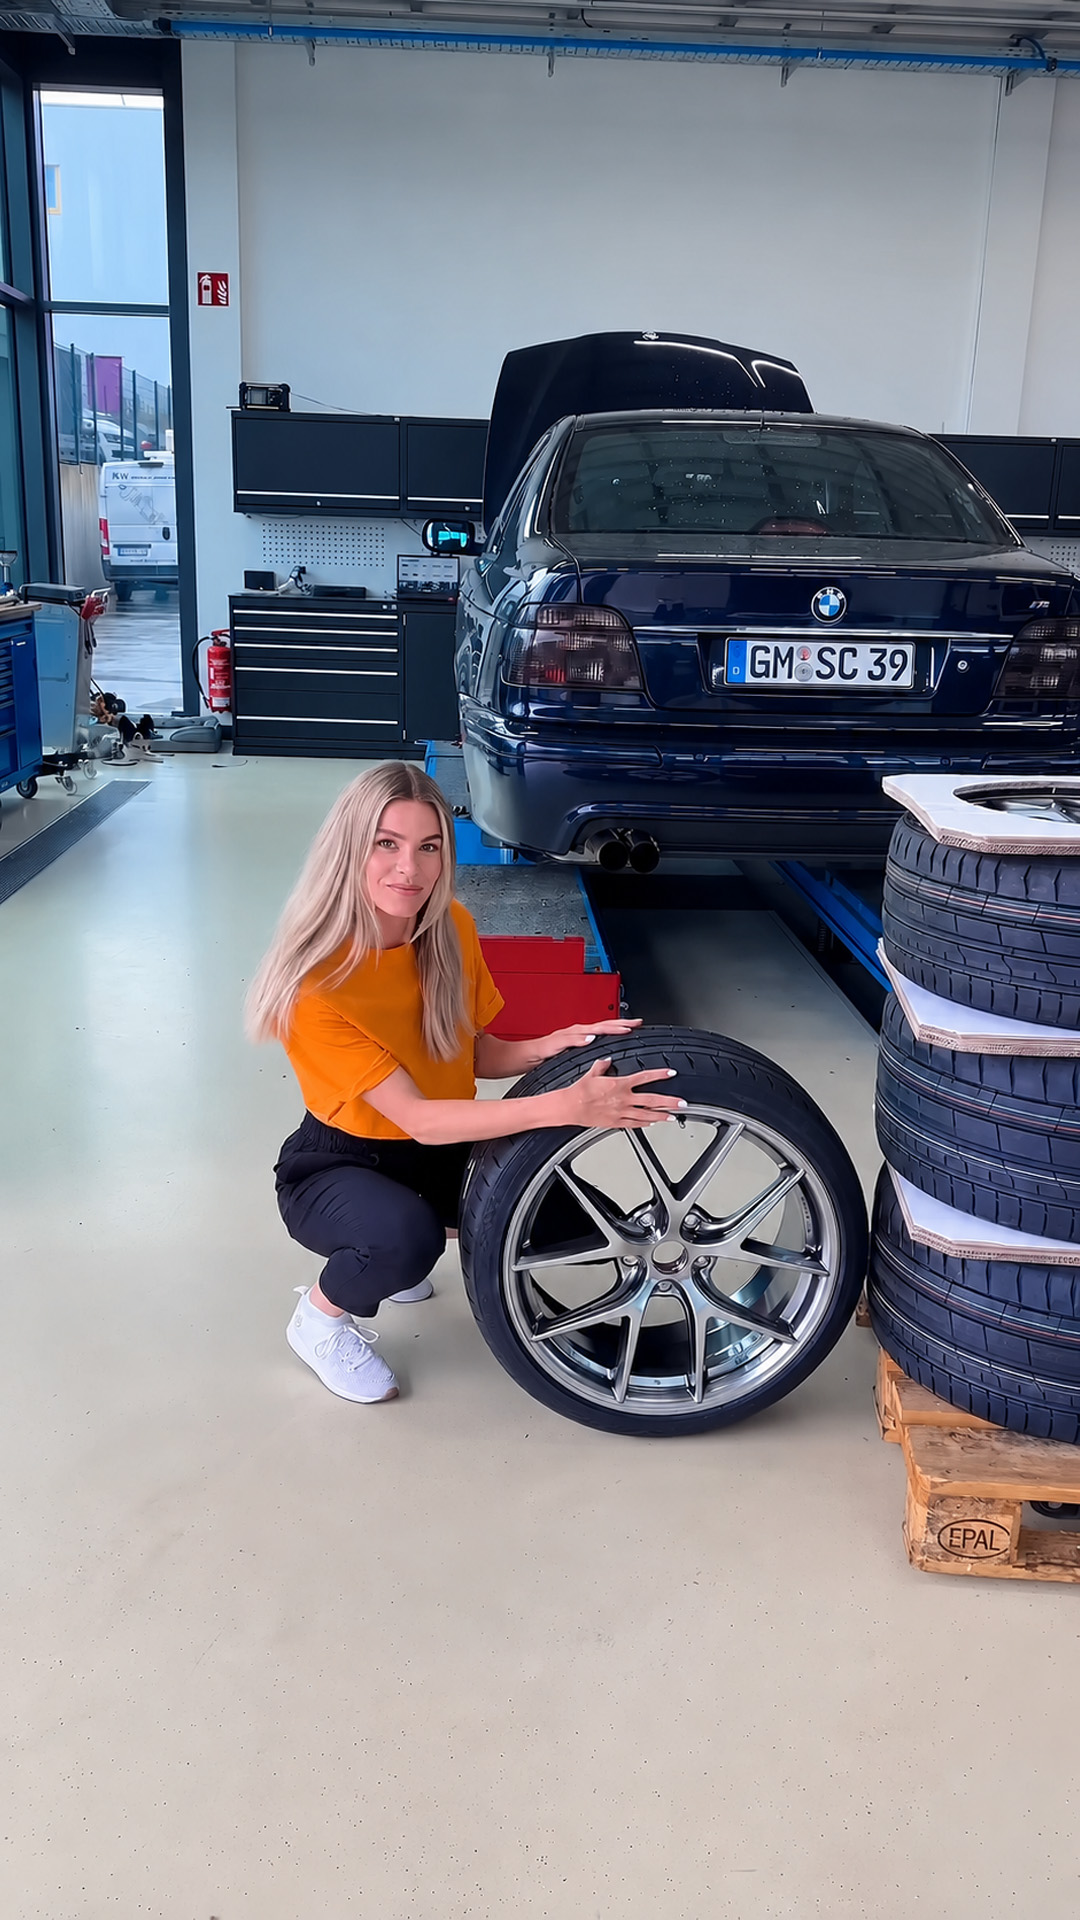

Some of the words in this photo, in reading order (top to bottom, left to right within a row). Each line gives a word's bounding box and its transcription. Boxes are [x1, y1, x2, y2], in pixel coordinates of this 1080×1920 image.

[750, 645, 794, 679] GM
[815, 646, 858, 681] SC
[867, 647, 908, 682] 39
[949, 1527, 1000, 1551] EPAL
